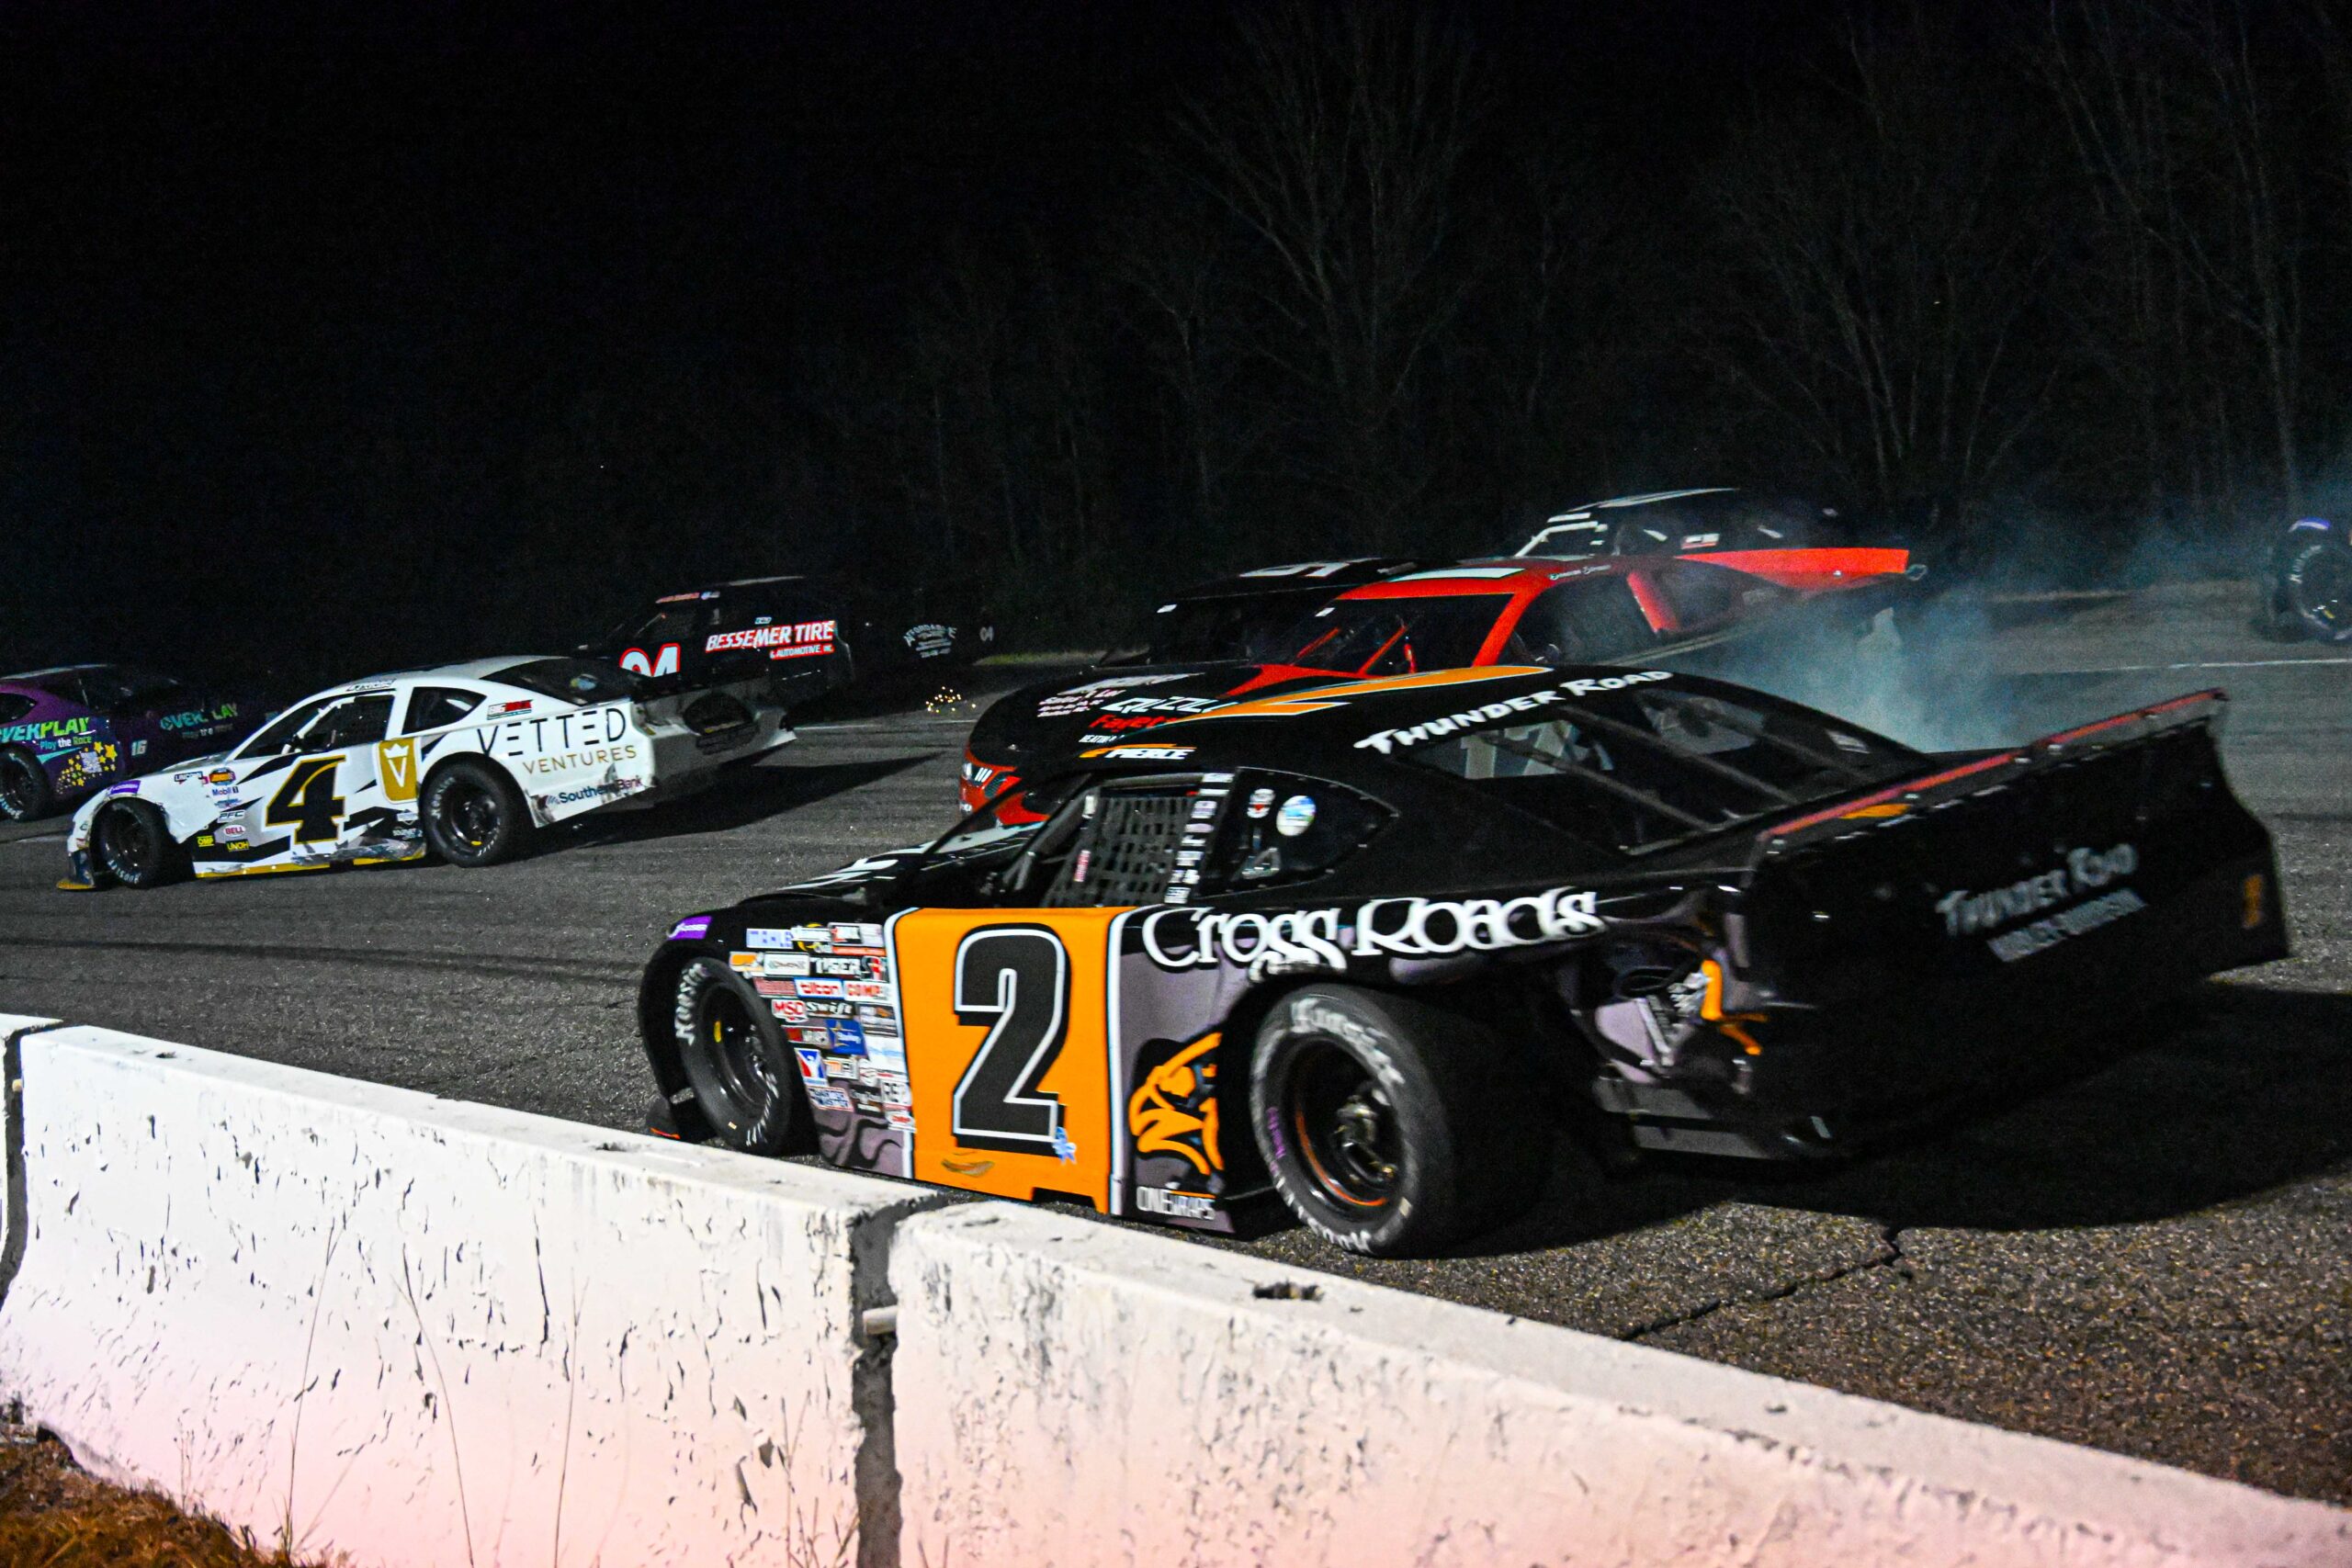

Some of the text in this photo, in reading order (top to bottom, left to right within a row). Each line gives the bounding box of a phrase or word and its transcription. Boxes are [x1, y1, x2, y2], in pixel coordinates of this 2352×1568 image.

[706, 620, 835, 652] BESSEMER TIRE
[1353, 690, 1566, 754] THUNDER
[1560, 671, 1674, 696] ROAD
[0, 717, 89, 743] VERPLAY
[58, 738, 72, 748] the
[477, 707, 627, 757] VETTED
[523, 745, 637, 774] VENTURES
[617, 775, 643, 791] Bank
[265, 754, 346, 844] 4
[220, 810, 244, 818] PFC
[224, 826, 244, 835] BELL
[1142, 886, 1607, 984] Cross Roads
[774, 1000, 805, 1016] MSD
[953, 922, 1070, 1156] 2
